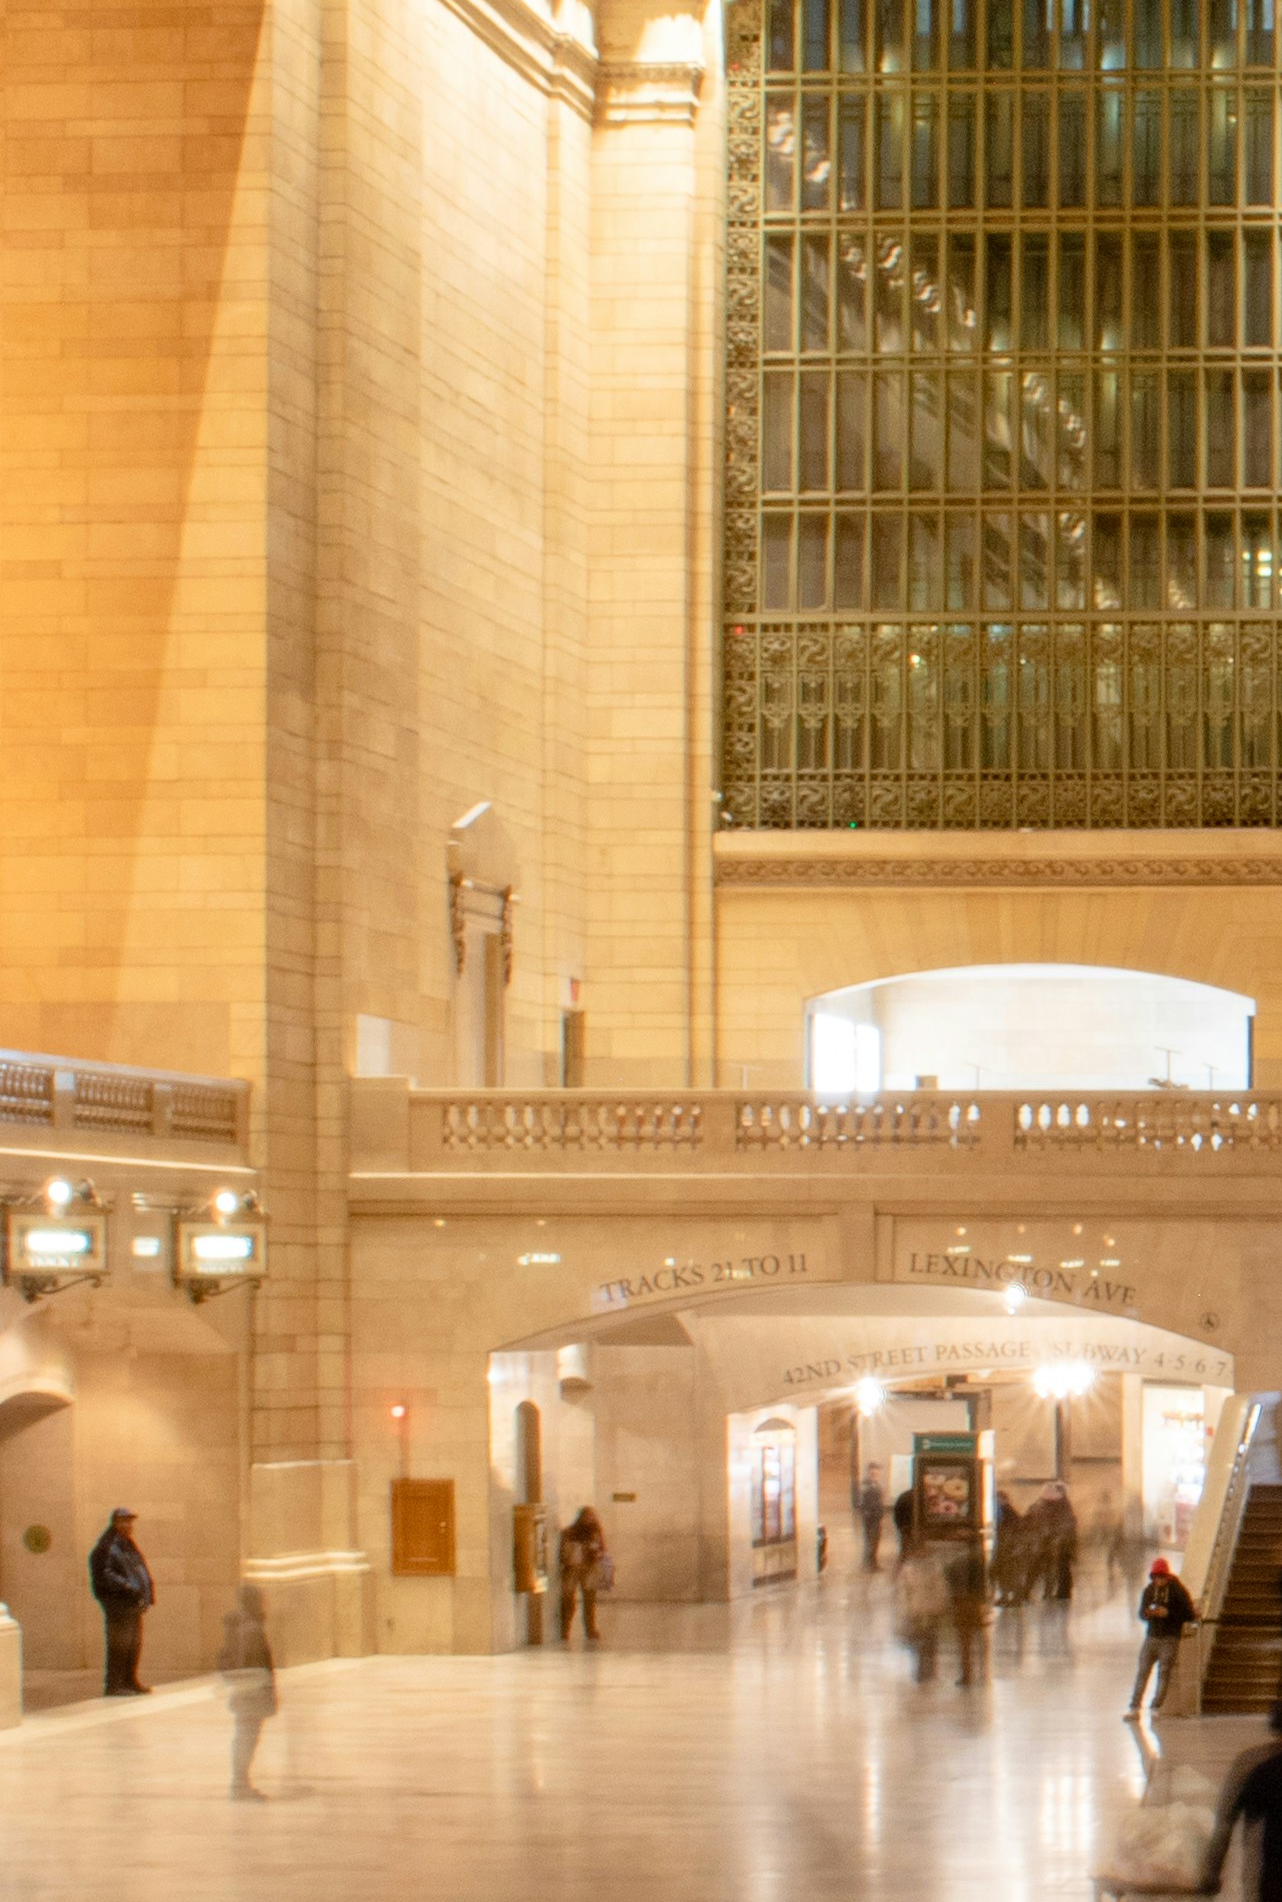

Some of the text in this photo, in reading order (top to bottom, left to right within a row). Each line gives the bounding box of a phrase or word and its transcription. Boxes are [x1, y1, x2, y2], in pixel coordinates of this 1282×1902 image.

[600, 1254, 808, 1302] TRACKS 21 TO 11
[910, 1252, 1136, 1306] LEXINGTON AVE
[783, 1359, 841, 1385] 42ND
[847, 1346, 928, 1370] STREET
[934, 1341, 1031, 1362] PASSAGE
[1052, 1342, 1148, 1365] SUBWAY
